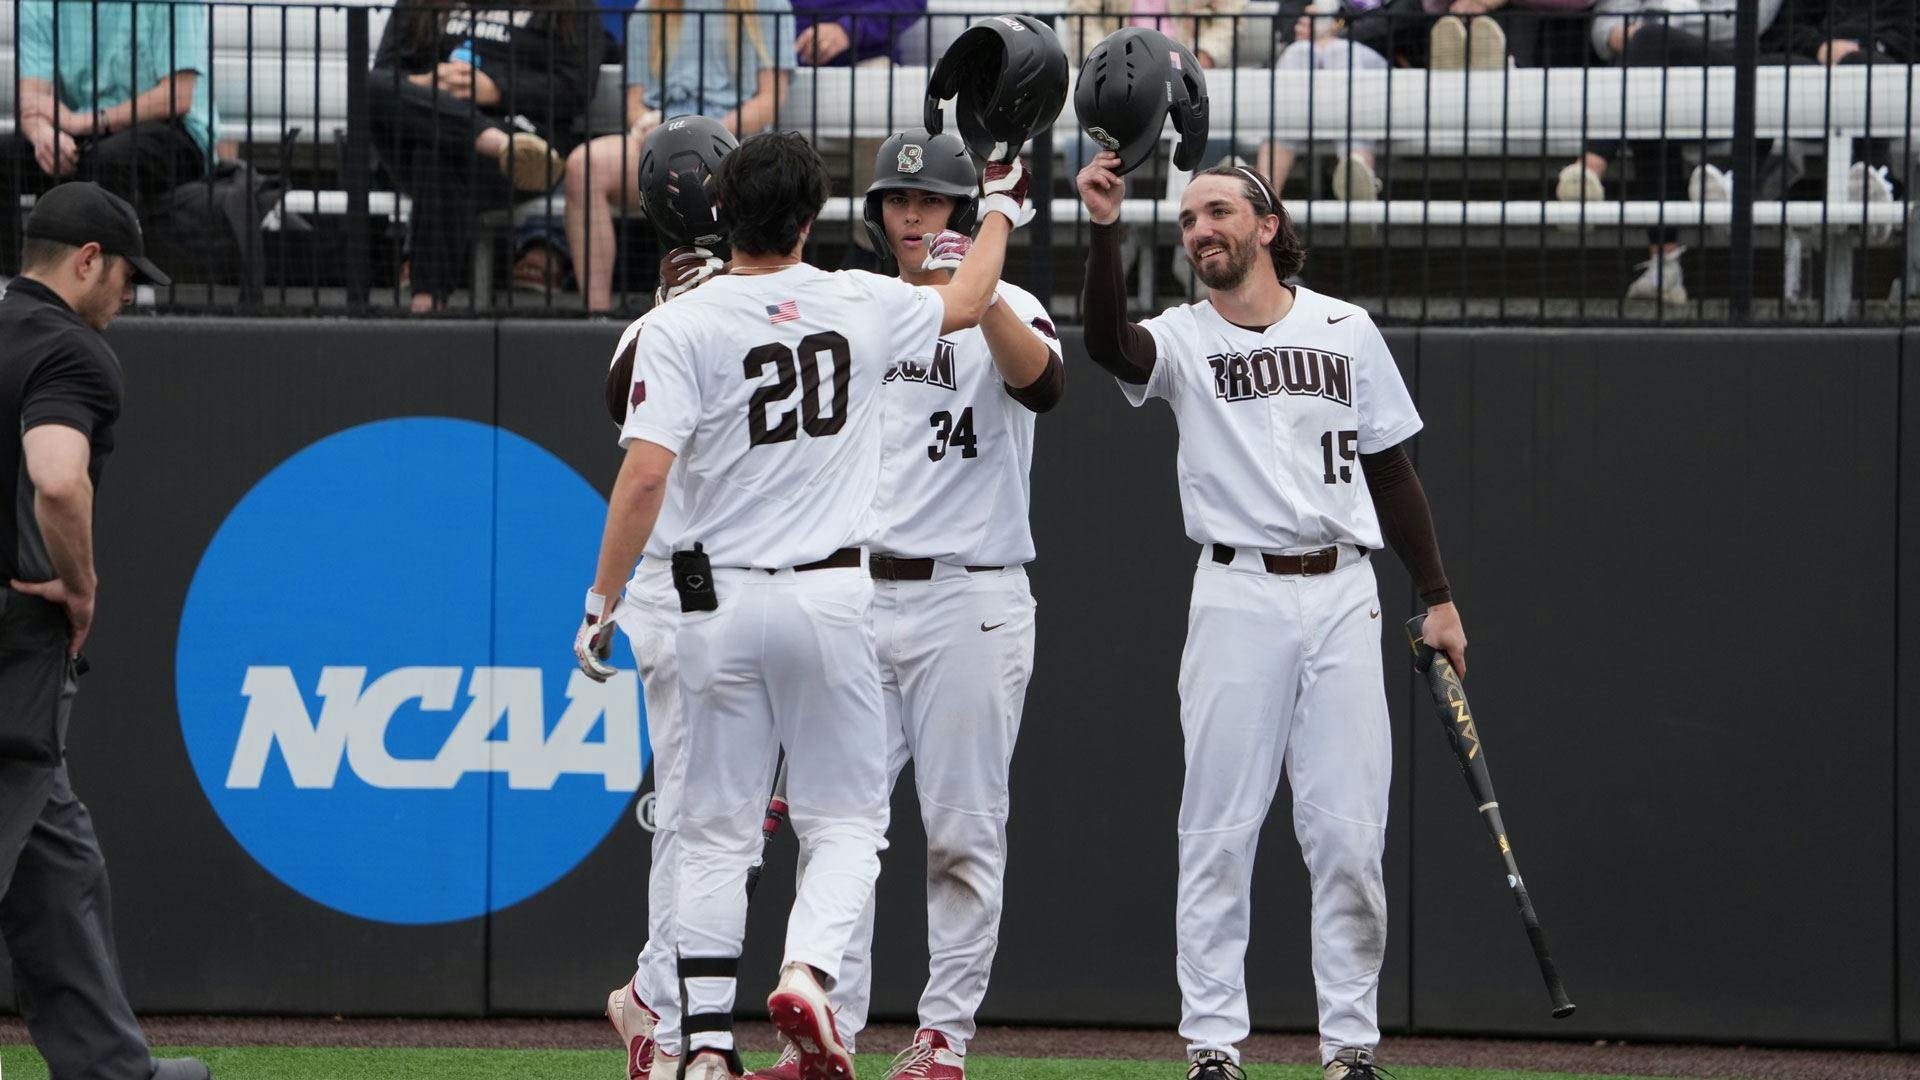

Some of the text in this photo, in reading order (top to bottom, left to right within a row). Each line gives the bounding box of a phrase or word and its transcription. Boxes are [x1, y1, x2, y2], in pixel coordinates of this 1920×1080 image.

[742, 330, 851, 450] 20
[927, 406, 978, 462] 34
[1321, 430, 1358, 484] 15
[225, 665, 643, 792] NCAA
